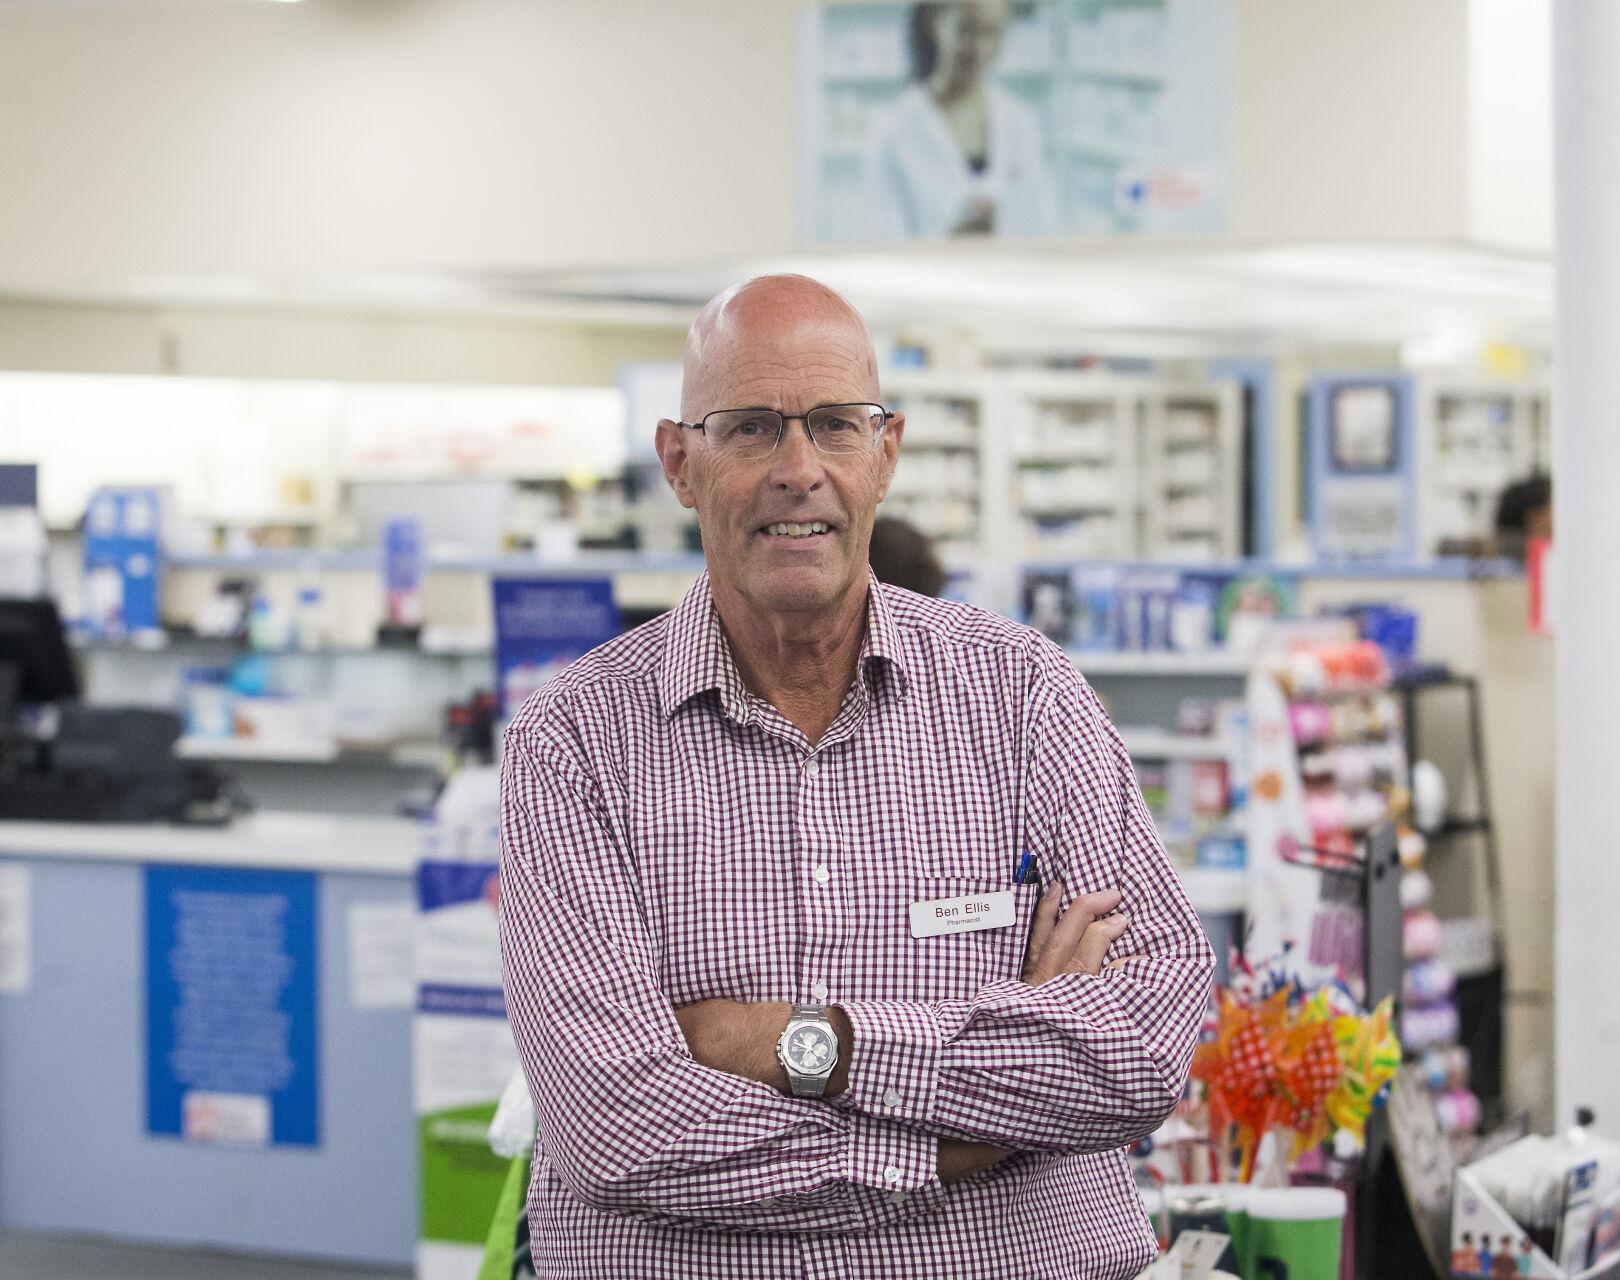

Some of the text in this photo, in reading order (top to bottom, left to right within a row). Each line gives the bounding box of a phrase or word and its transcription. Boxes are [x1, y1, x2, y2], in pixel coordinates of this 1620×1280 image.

[935, 902, 990, 918] Ben Ellis
[946, 917, 981, 926] Pharmacist
